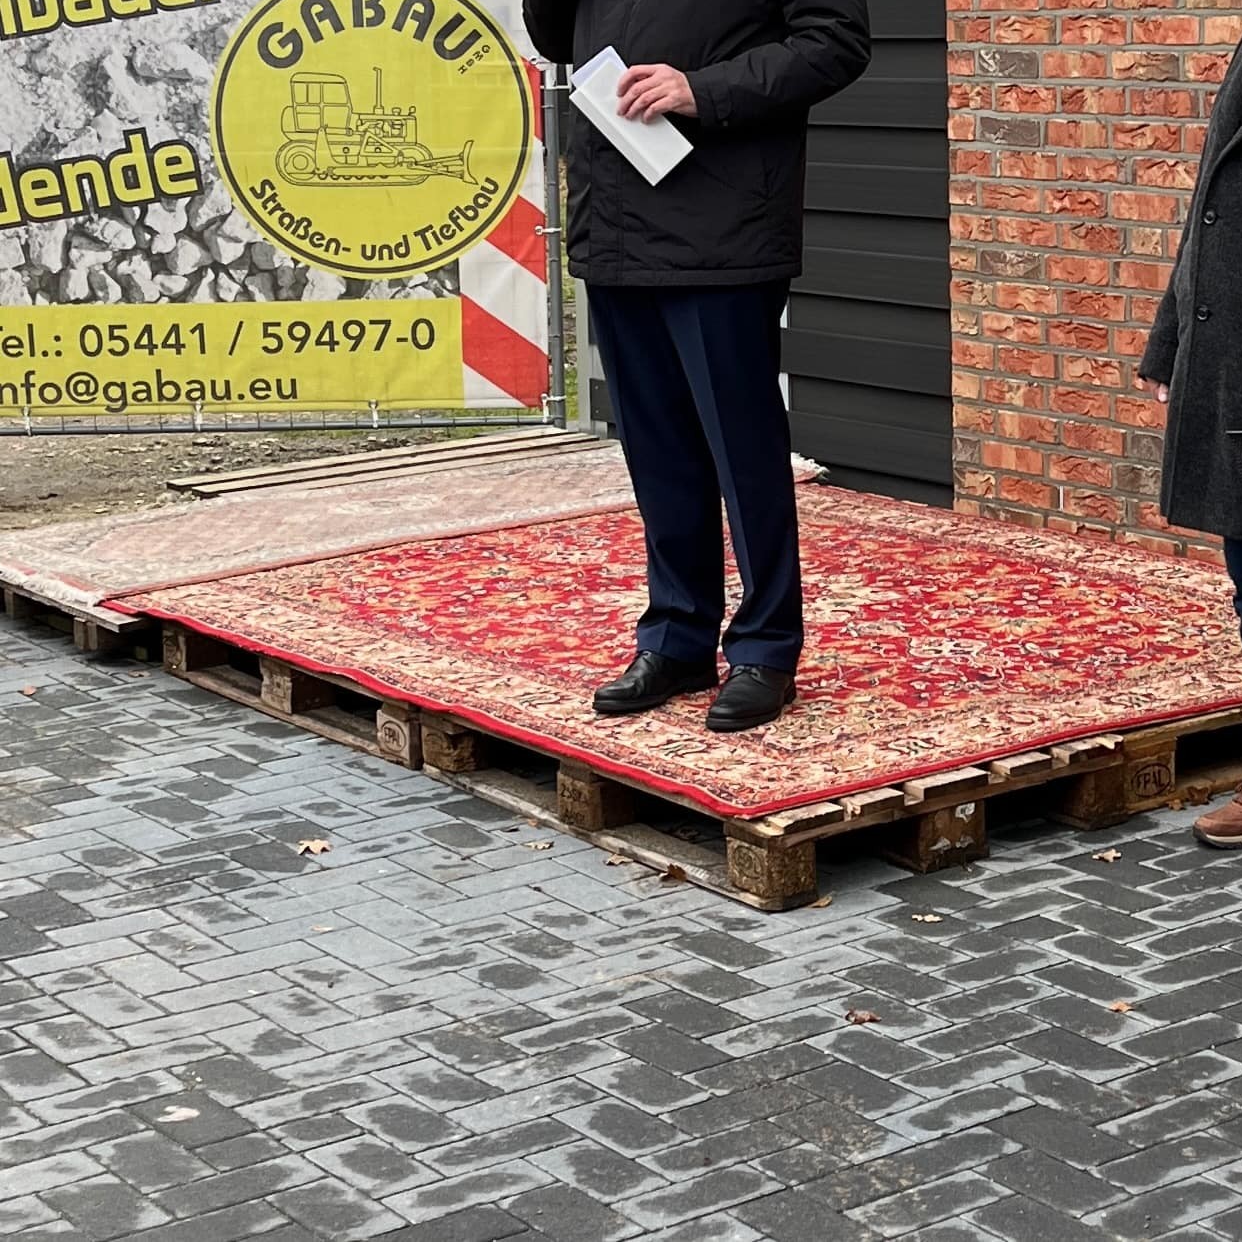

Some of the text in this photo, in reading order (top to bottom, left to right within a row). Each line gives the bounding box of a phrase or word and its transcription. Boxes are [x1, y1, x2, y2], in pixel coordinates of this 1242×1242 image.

[250, 176, 500, 261] Straßen- und Tiefbau
[0, 318, 436, 358] el.: 05441 / 59497-0
